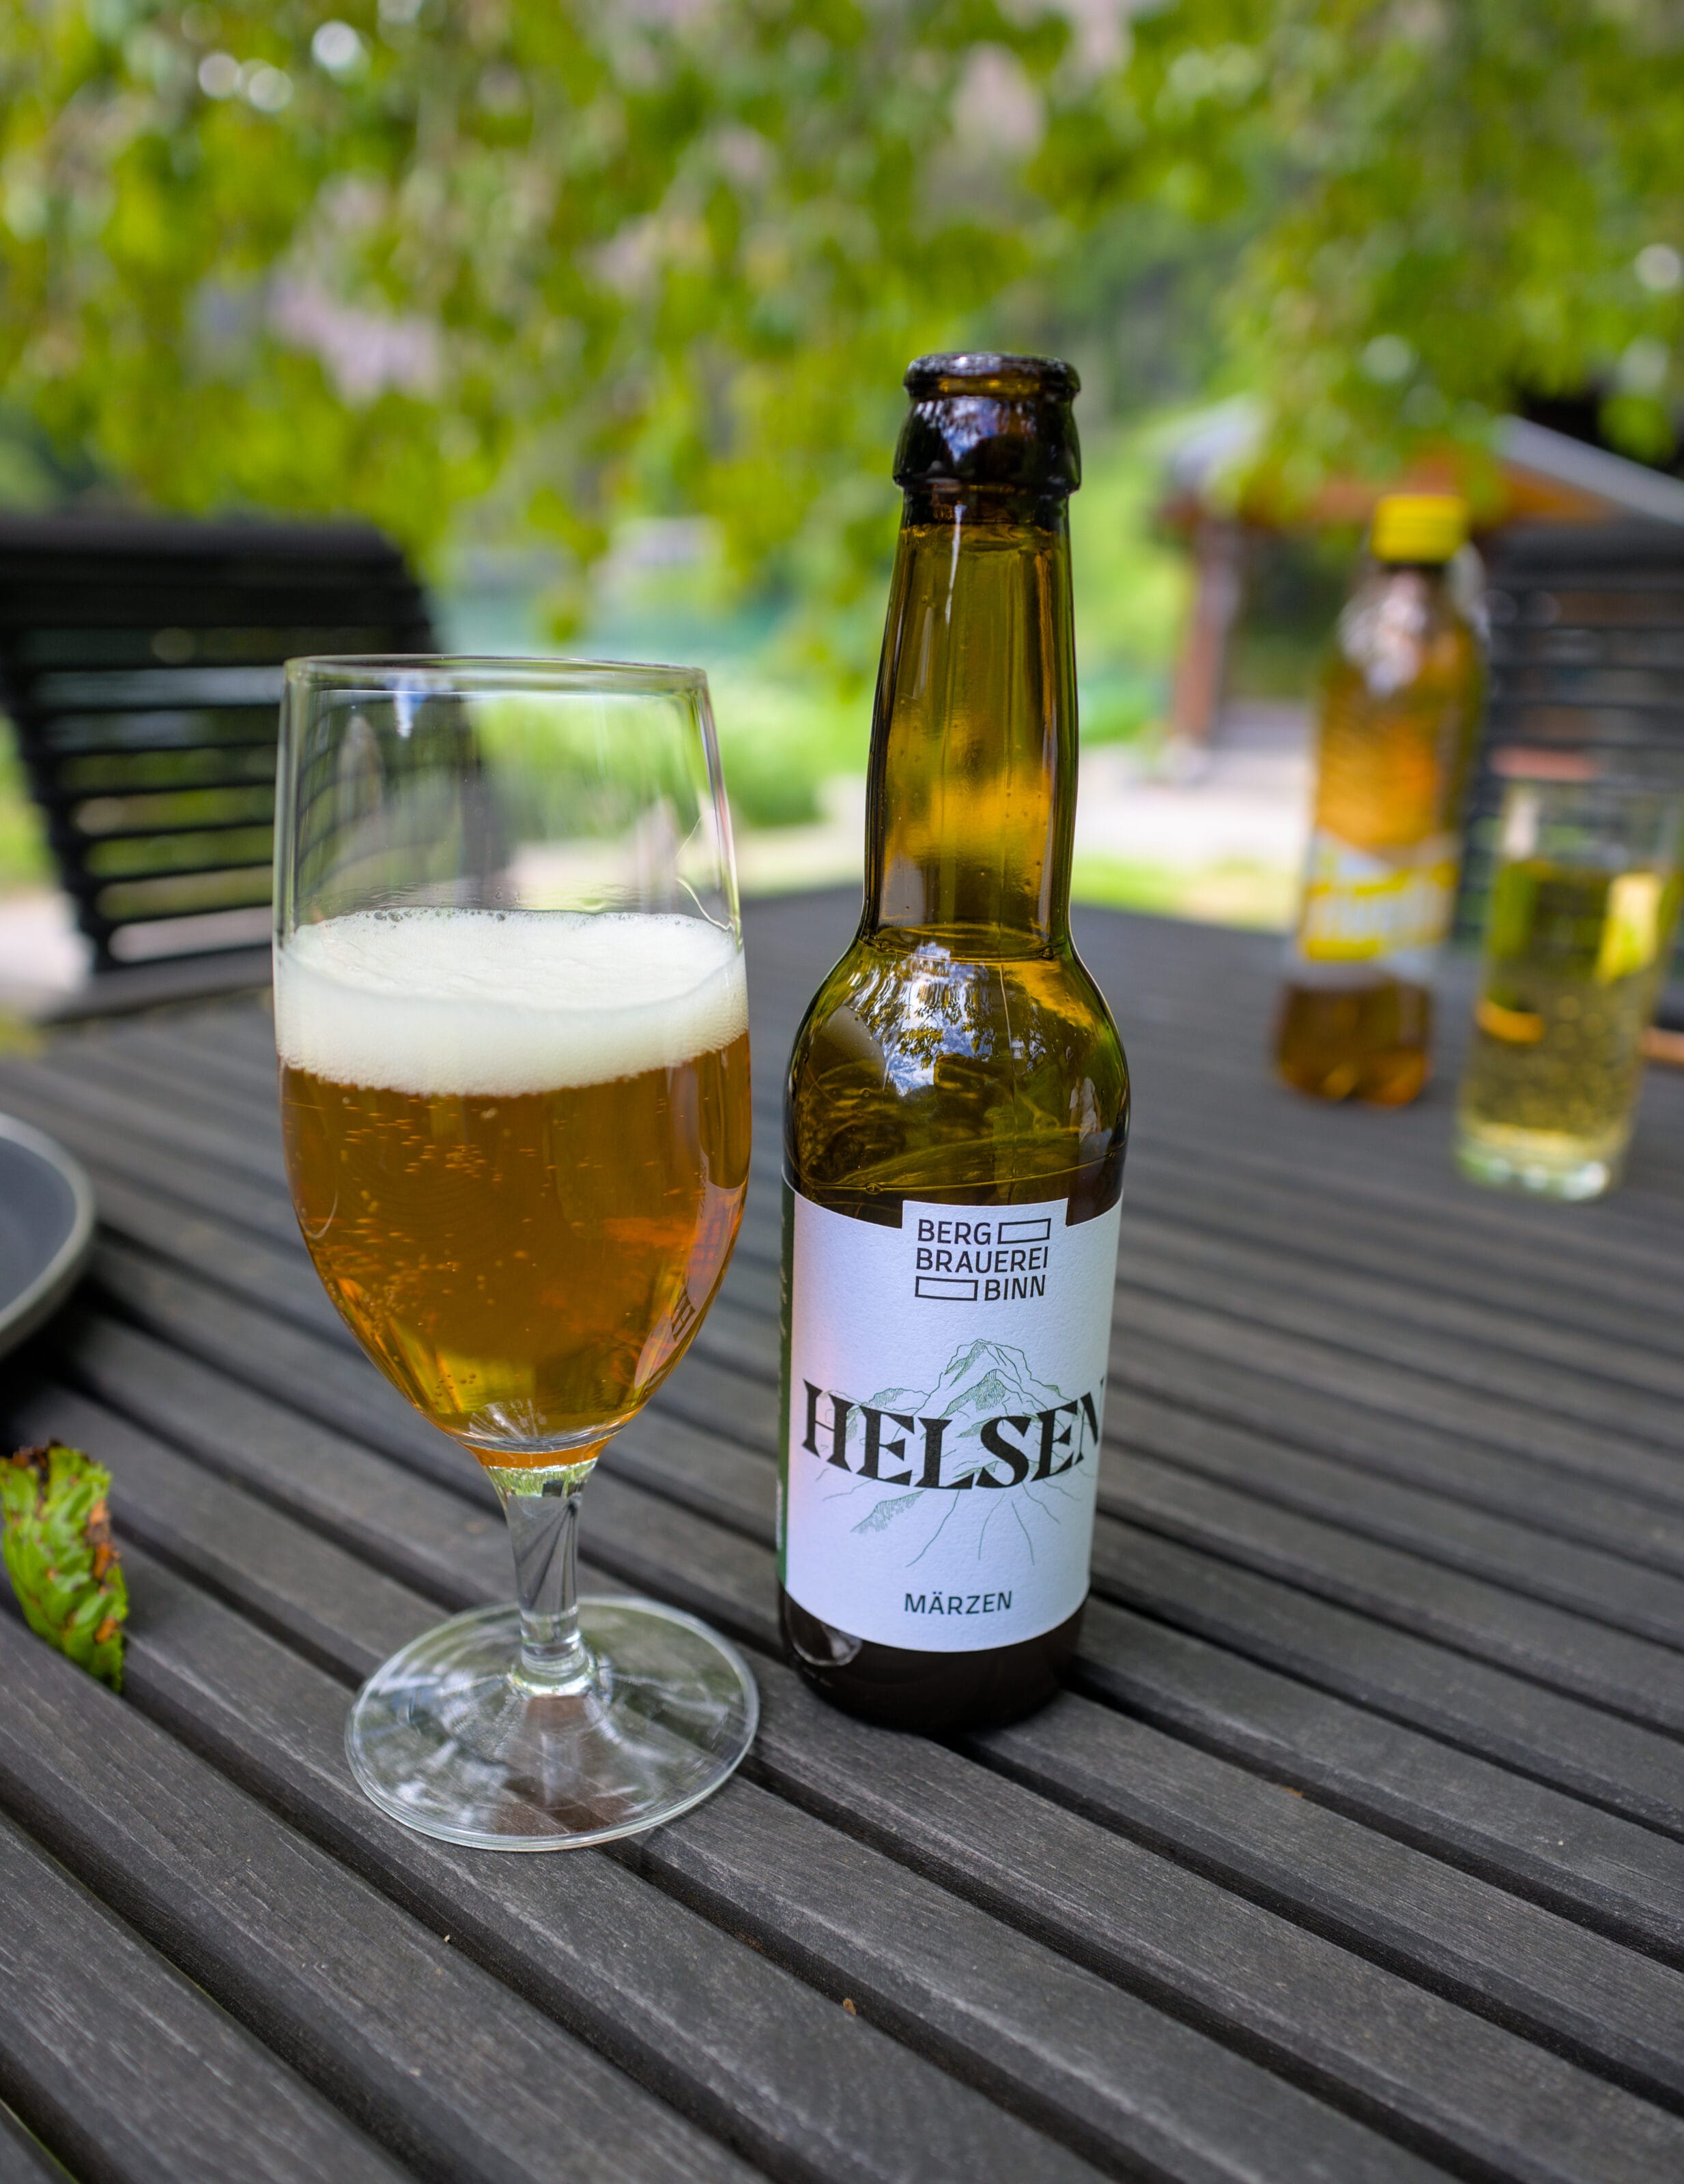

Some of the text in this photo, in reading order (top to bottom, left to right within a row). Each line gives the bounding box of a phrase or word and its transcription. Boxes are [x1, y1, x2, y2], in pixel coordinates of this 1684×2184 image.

[918, 1219, 990, 1245] BERG
[916, 1246, 1048, 1274] BRAUEREI
[984, 1274, 1046, 1301] BINN
[904, 1590, 1012, 1615] MÄRZEN
